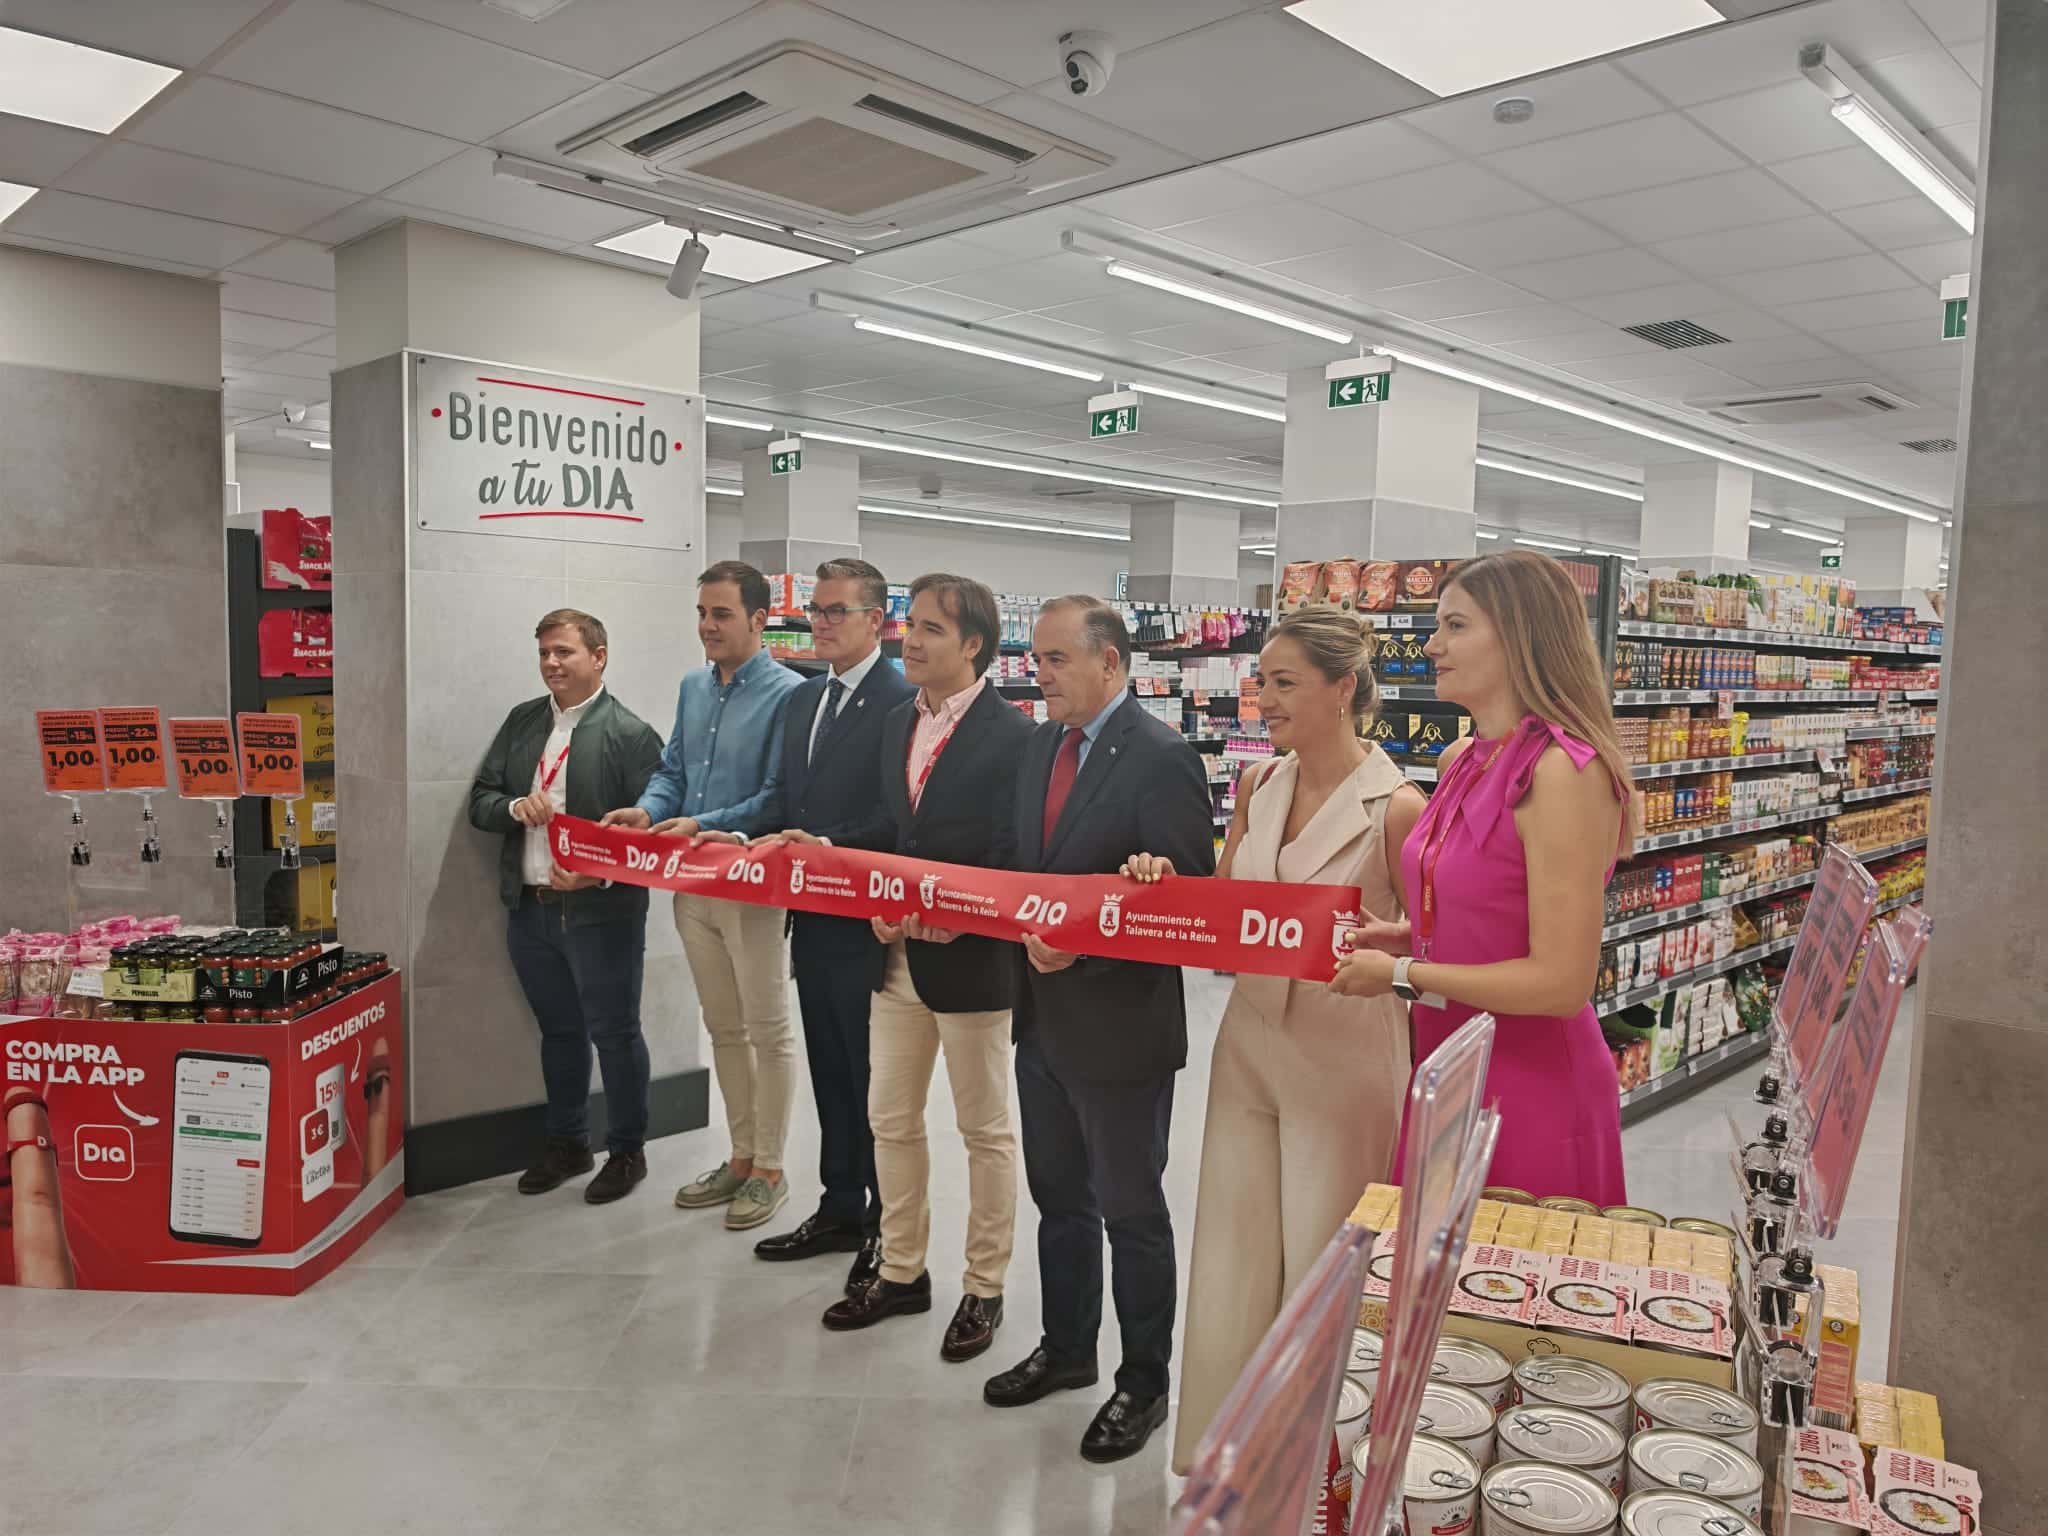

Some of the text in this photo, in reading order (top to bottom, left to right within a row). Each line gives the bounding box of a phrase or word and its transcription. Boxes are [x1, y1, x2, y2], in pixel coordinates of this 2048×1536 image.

[449, 391, 667, 466] Bienvenido
[478, 459, 634, 511] a tu DIA
[626, 845, 660, 872] Dia
[726, 858, 765, 884] Dia
[869, 870, 905, 901] Dia
[937, 887, 995, 905] Ayuntamiento de
[937, 900, 999, 918] Talavera de la Reina
[1014, 894, 1068, 926] Dia
[1125, 911, 1206, 927] Ayuntamiento de
[1125, 925, 1217, 944] Talavera de la Reina
[1240, 909, 1303, 949] Dia
[318, 959, 338, 977] Pisto
[229, 988, 253, 1000] Pisto
[301, 1001, 385, 1061] DESCUENTOS
[6, 1040, 122, 1065] COMPRA
[6, 1061, 145, 1086] EN LA APP
[83, 1143, 126, 1163] Dia
[1889, 1453, 1911, 1481] COCIDO
[1914, 1458, 1936, 1488] ARROZ
